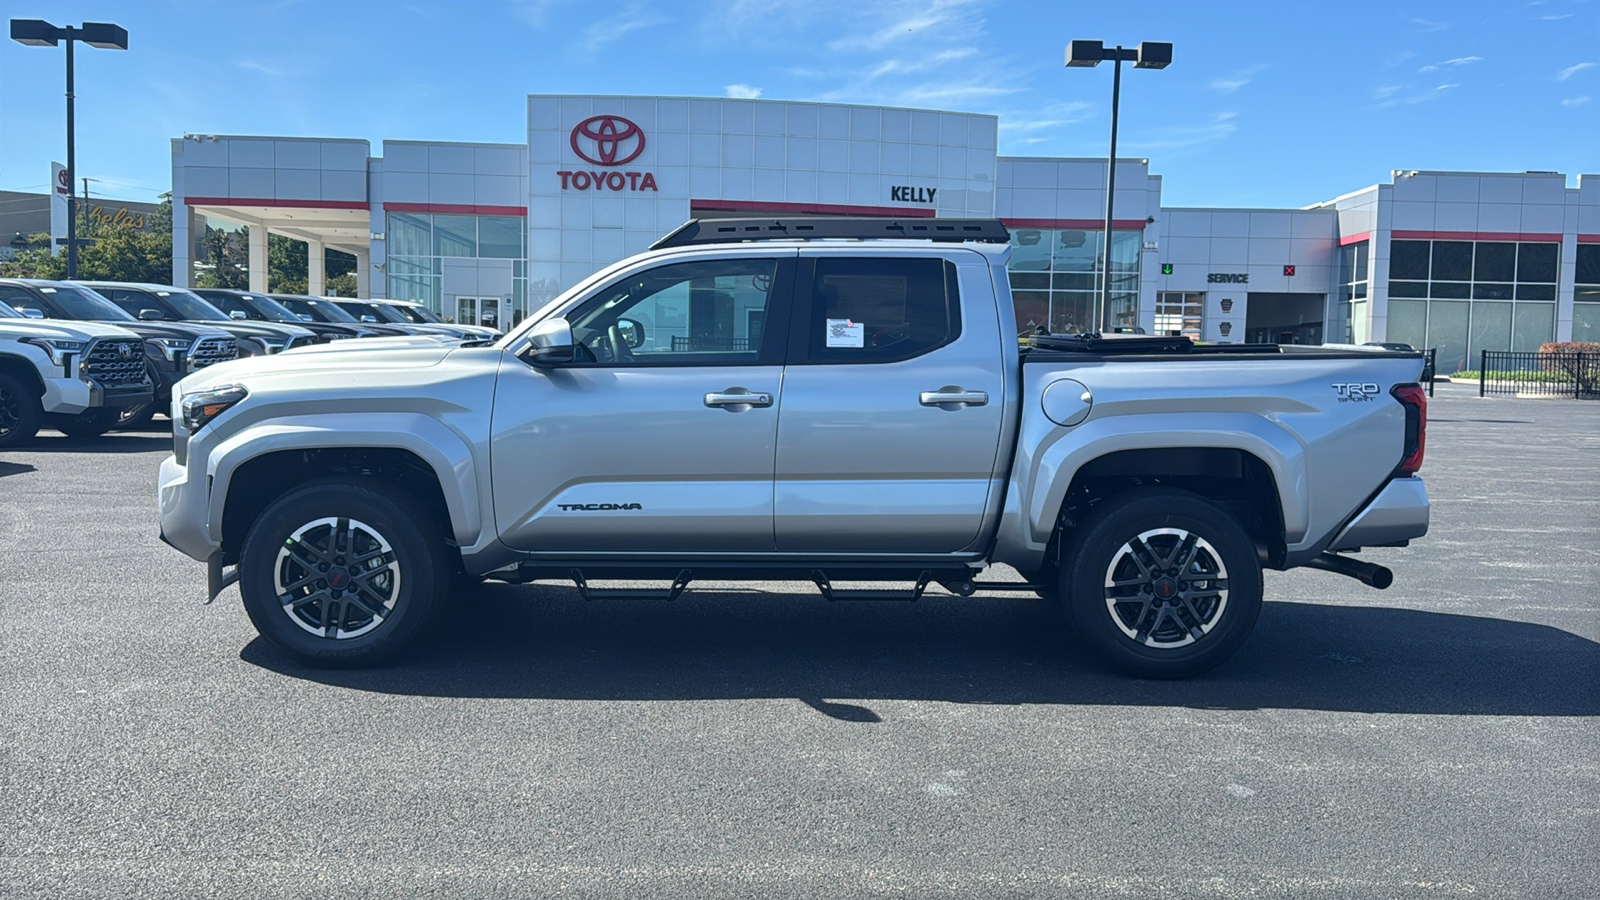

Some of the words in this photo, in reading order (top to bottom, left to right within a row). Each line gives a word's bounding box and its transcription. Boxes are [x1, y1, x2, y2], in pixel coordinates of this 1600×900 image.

[557, 171, 658, 191] TOYOTA
[891, 185, 937, 203] KELLY
[1207, 273, 1249, 283] SERVICE
[1331, 382, 1380, 397] TRD
[557, 503, 642, 511] TACOMA
